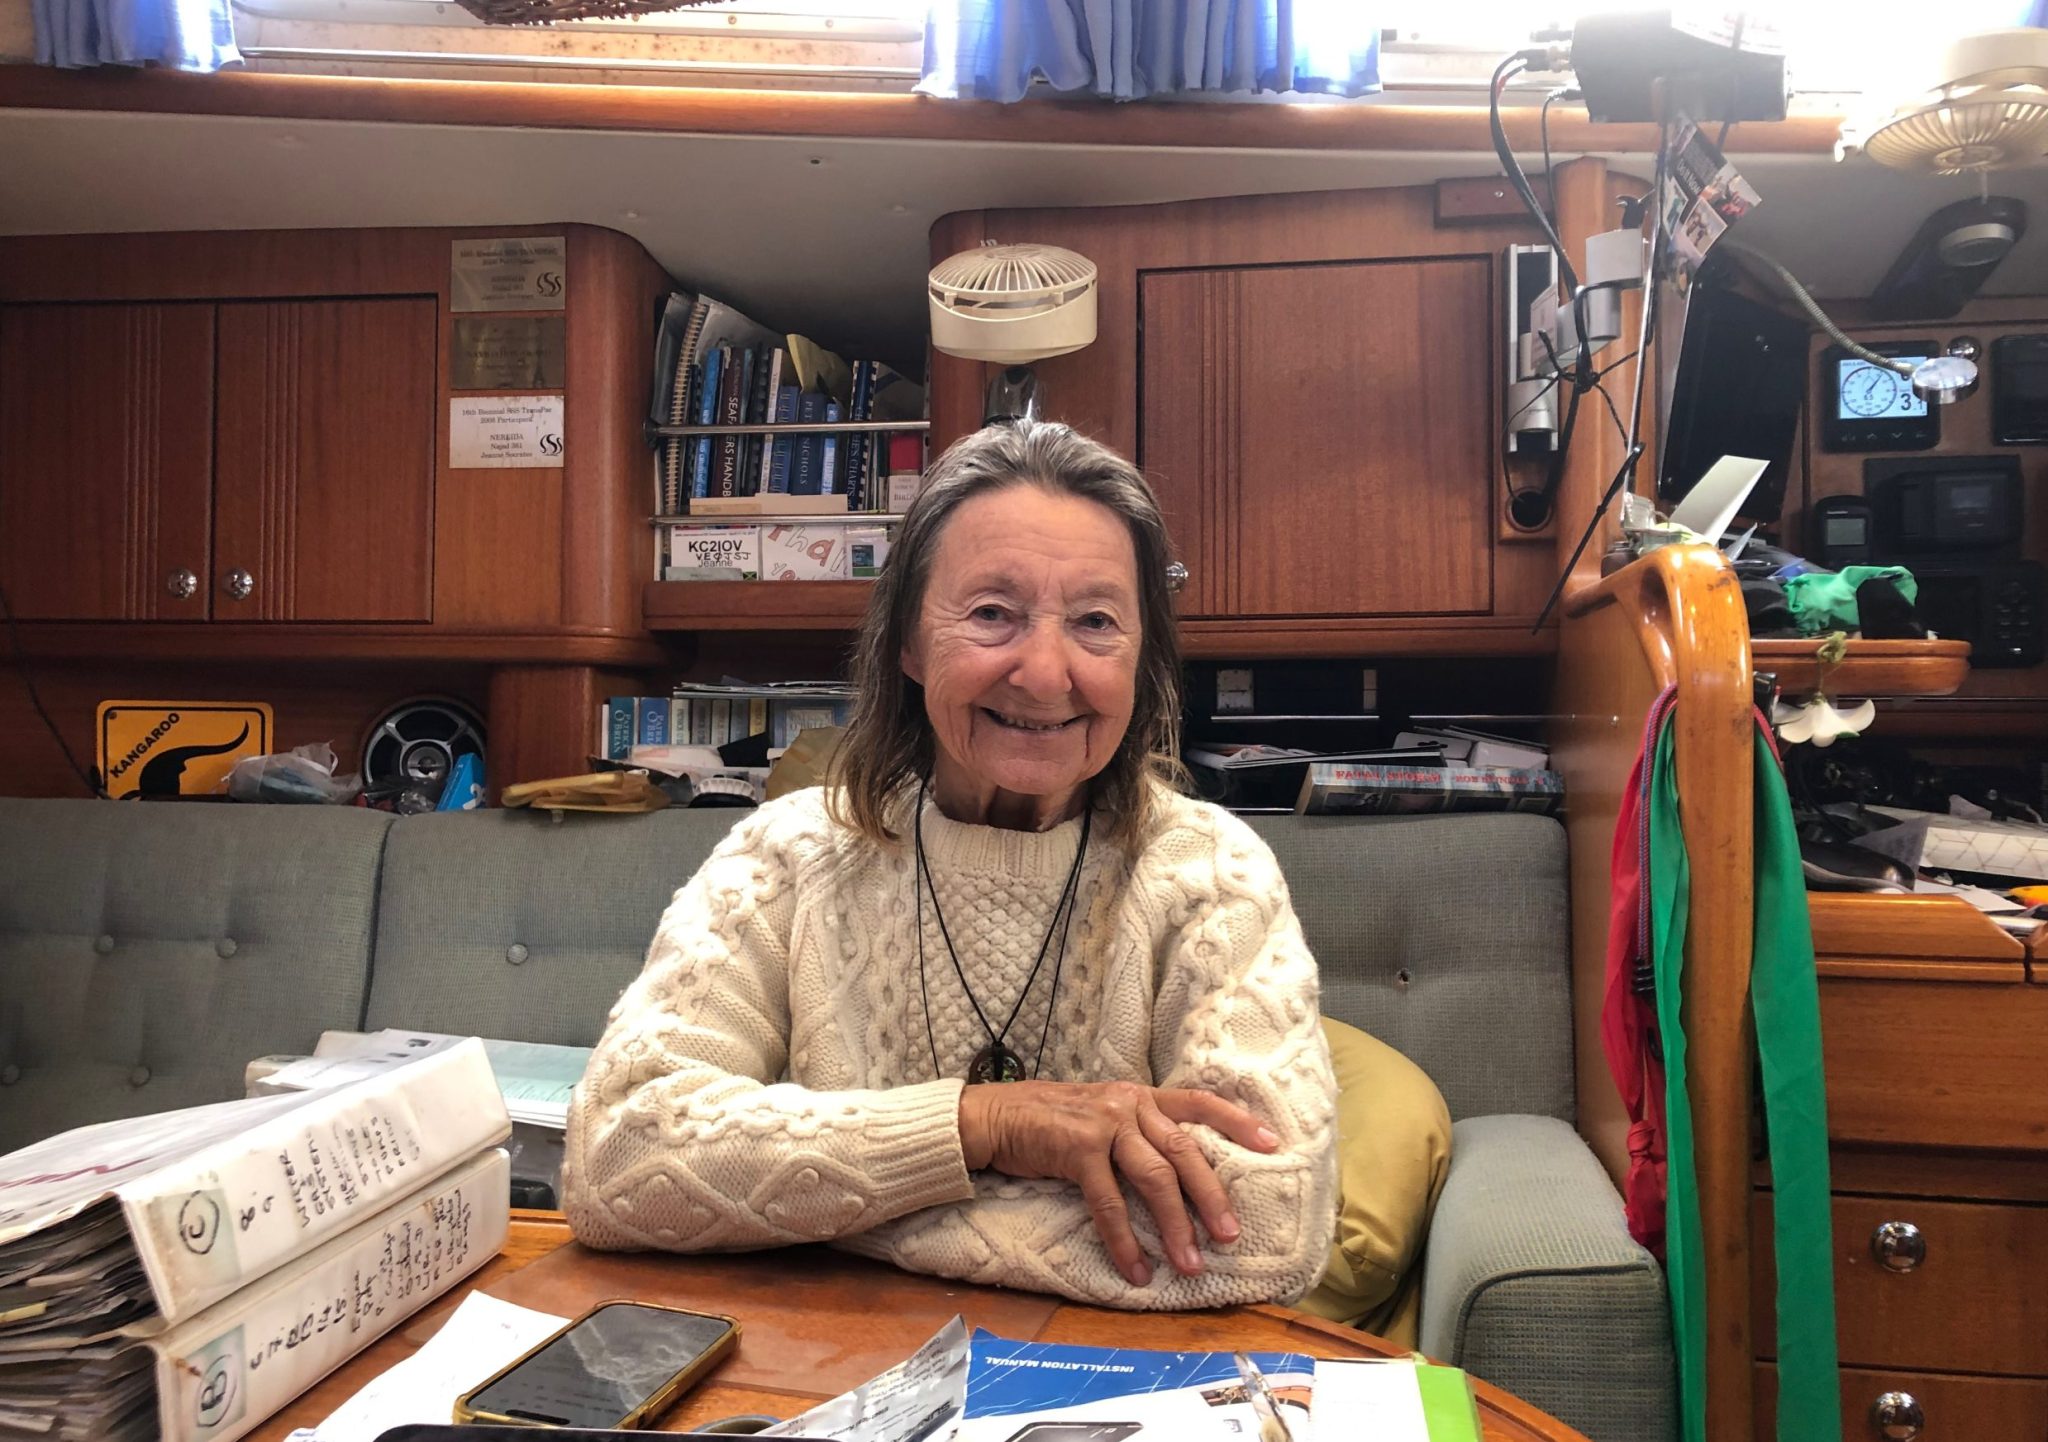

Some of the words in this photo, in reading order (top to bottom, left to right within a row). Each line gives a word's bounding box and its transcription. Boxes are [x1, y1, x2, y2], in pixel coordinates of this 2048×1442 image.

[725, 397, 739, 455] SEAFERS
[722, 456, 735, 497] HANDB
[698, 560, 734, 568] Jeanne
[656, 714, 664, 743] PATRIC
[110, 712, 182, 779] KANGAROO
[984, 1355, 1038, 1368] MANUAL
[1042, 1360, 1134, 1374] INSTALLATION
